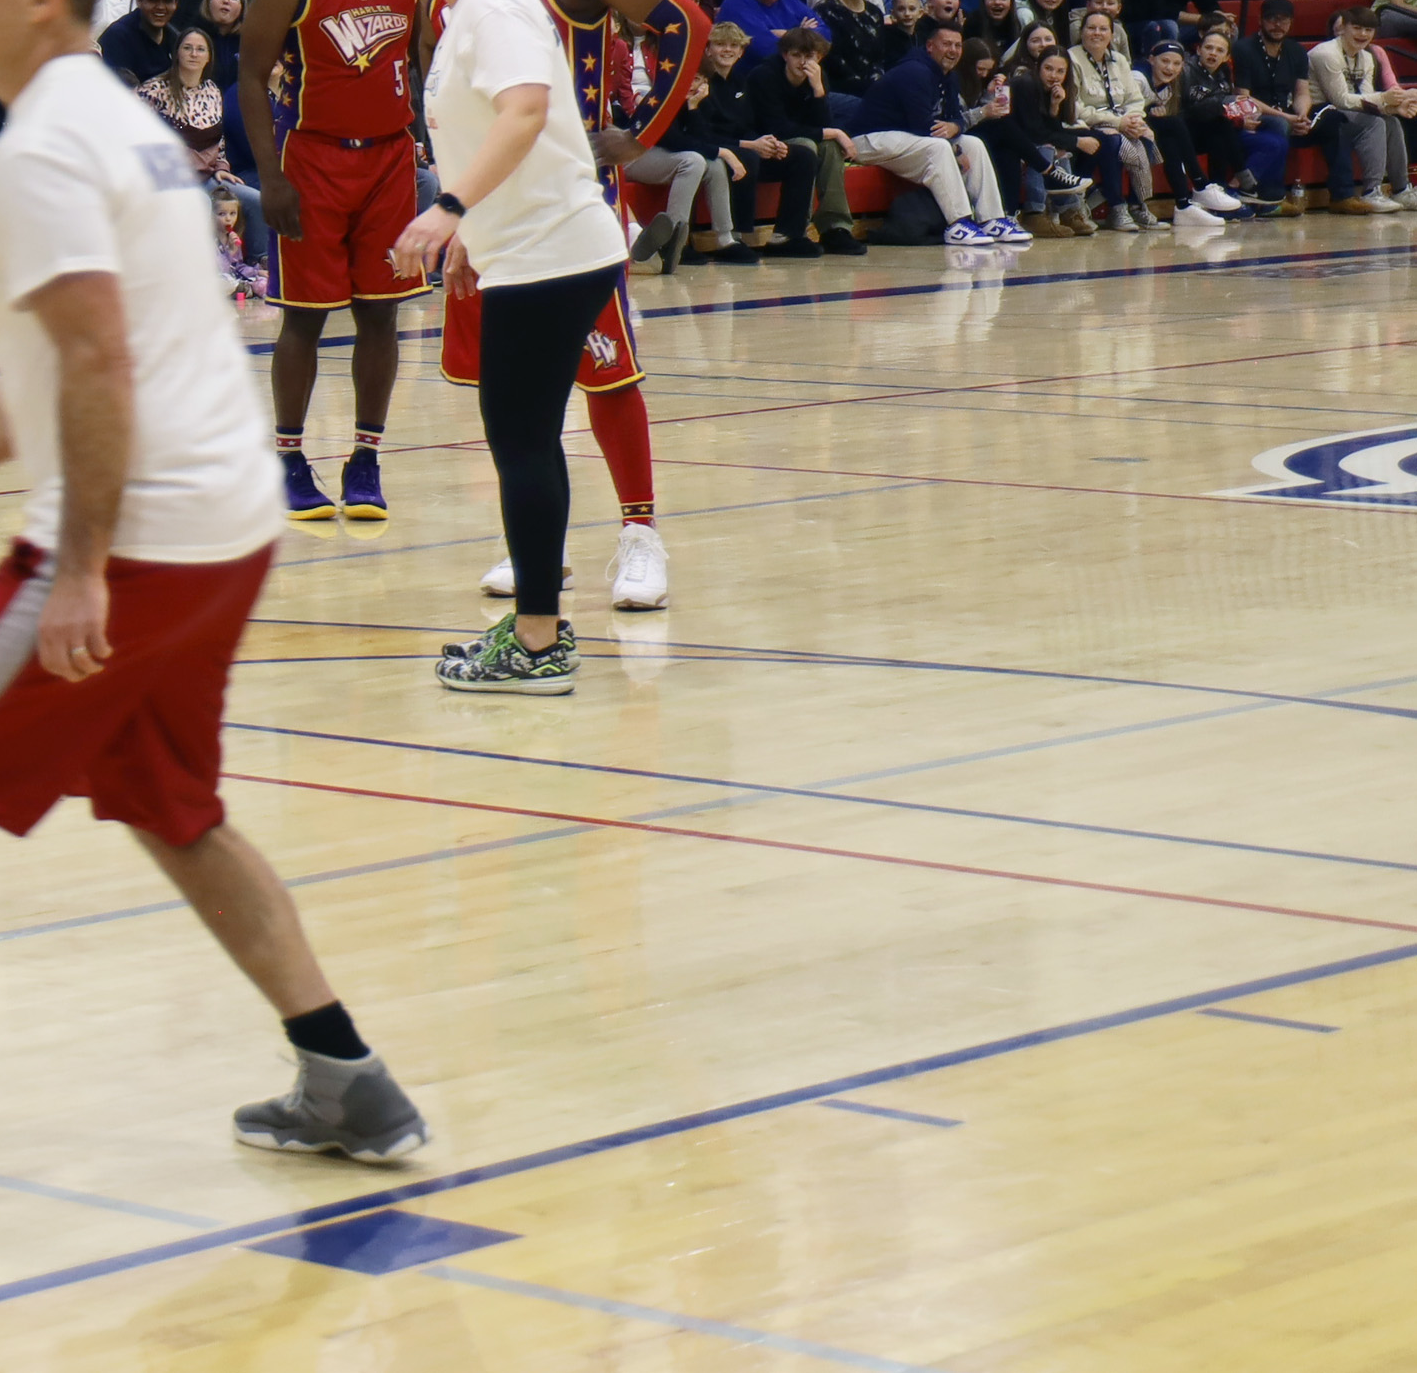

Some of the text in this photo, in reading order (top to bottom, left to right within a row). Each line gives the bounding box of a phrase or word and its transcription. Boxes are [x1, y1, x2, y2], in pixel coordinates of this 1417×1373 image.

[351, 5, 391, 18] HARLEM
[321, 11, 408, 61] WIZARDS
[393, 60, 405, 97] 5
